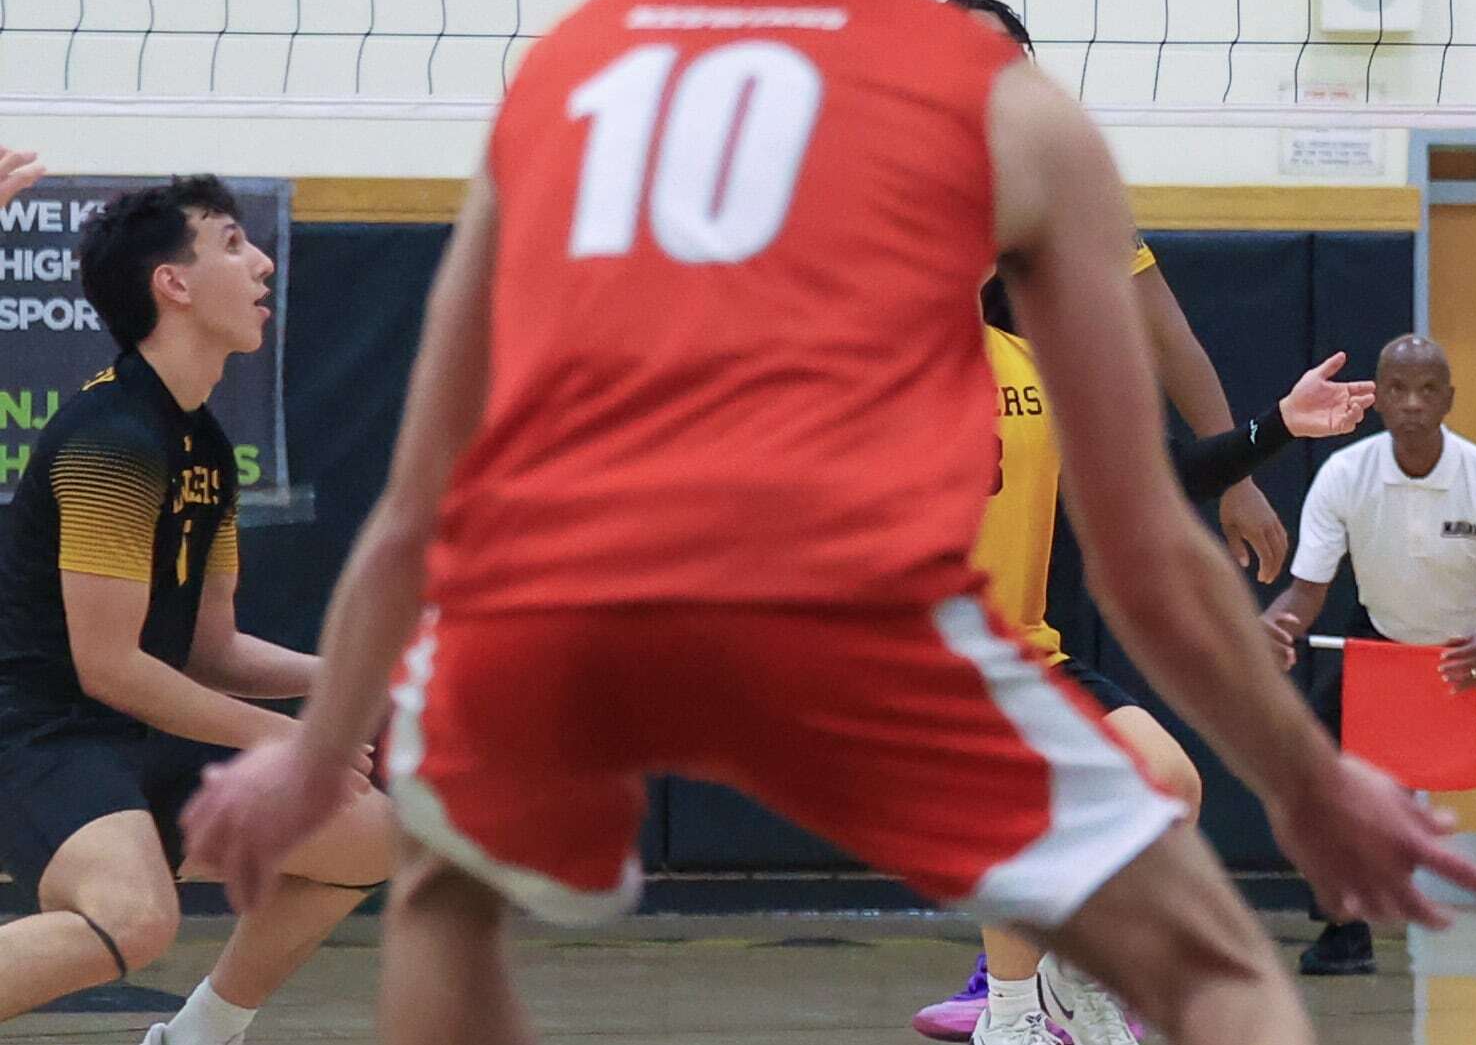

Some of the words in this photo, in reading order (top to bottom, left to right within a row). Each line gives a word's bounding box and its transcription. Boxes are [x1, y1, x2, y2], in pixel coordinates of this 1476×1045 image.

[566, 39, 825, 265] 10
[0, 199, 62, 232] WE
[0, 297, 101, 331] SPOR
